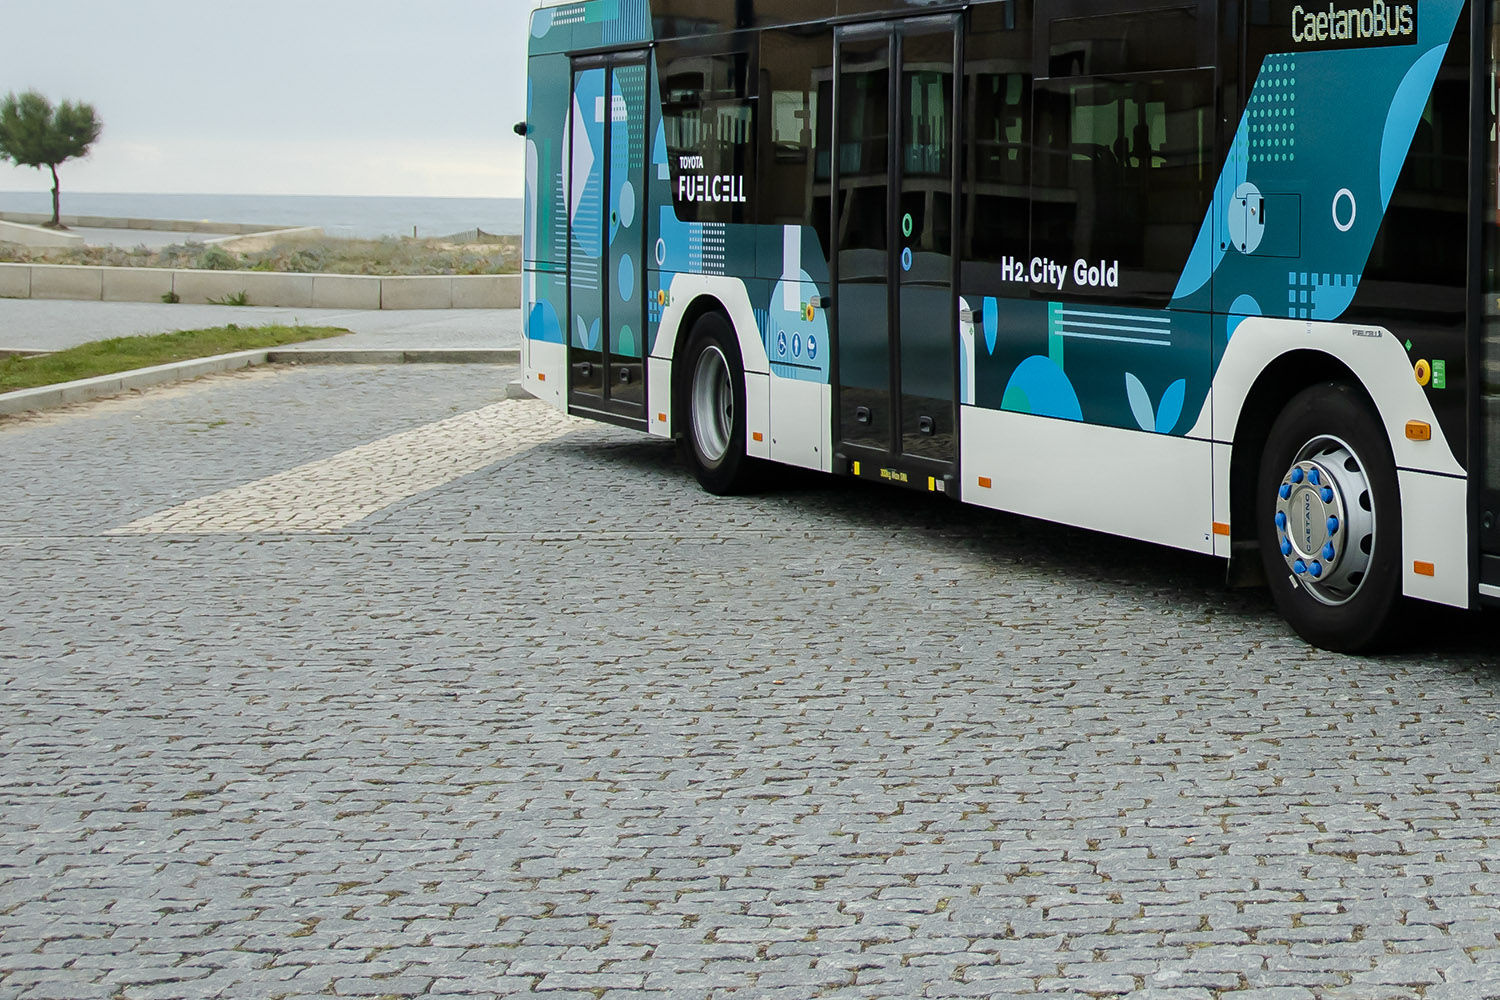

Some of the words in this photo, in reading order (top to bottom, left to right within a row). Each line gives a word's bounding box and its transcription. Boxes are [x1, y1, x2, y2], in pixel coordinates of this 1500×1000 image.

[679, 155, 704, 170] TOYOTA
[678, 175, 747, 203] FUELCELL
[1001, 255, 1068, 291] H2.City
[1073, 258, 1119, 288] Gold
[1304, 493, 1312, 552] CAETANO
